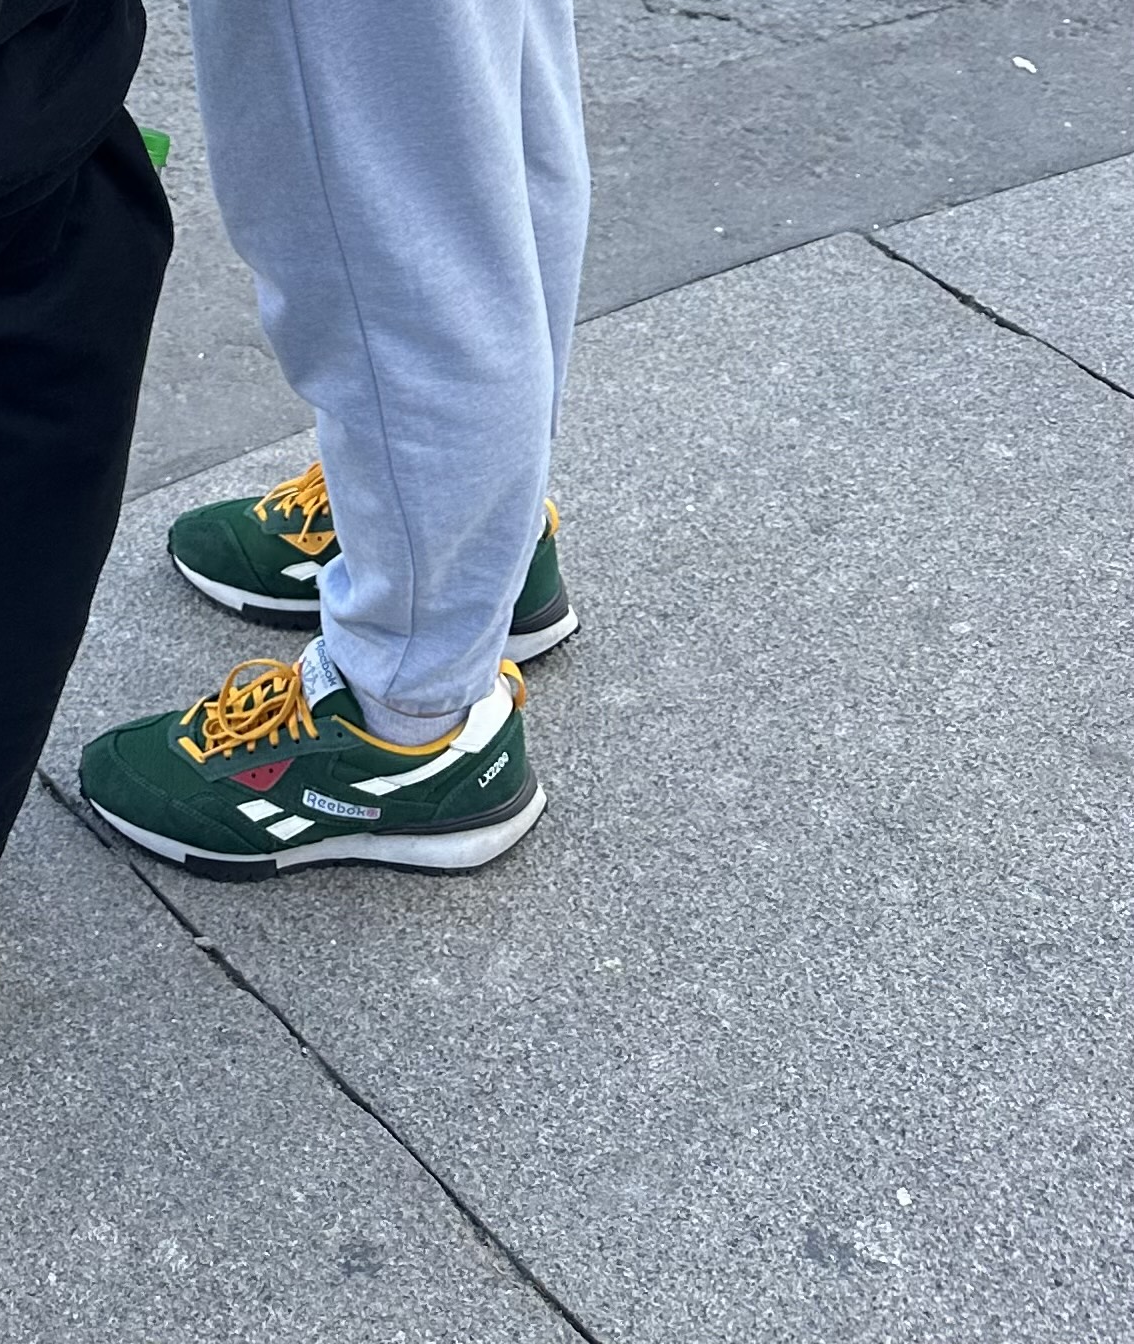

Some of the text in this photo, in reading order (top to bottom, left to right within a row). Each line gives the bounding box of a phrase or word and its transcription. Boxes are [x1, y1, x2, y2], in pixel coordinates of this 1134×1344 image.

[315, 639, 337, 687] Reebok
[477, 751, 510, 788] LX2200
[306, 792, 366, 816] Reebok
